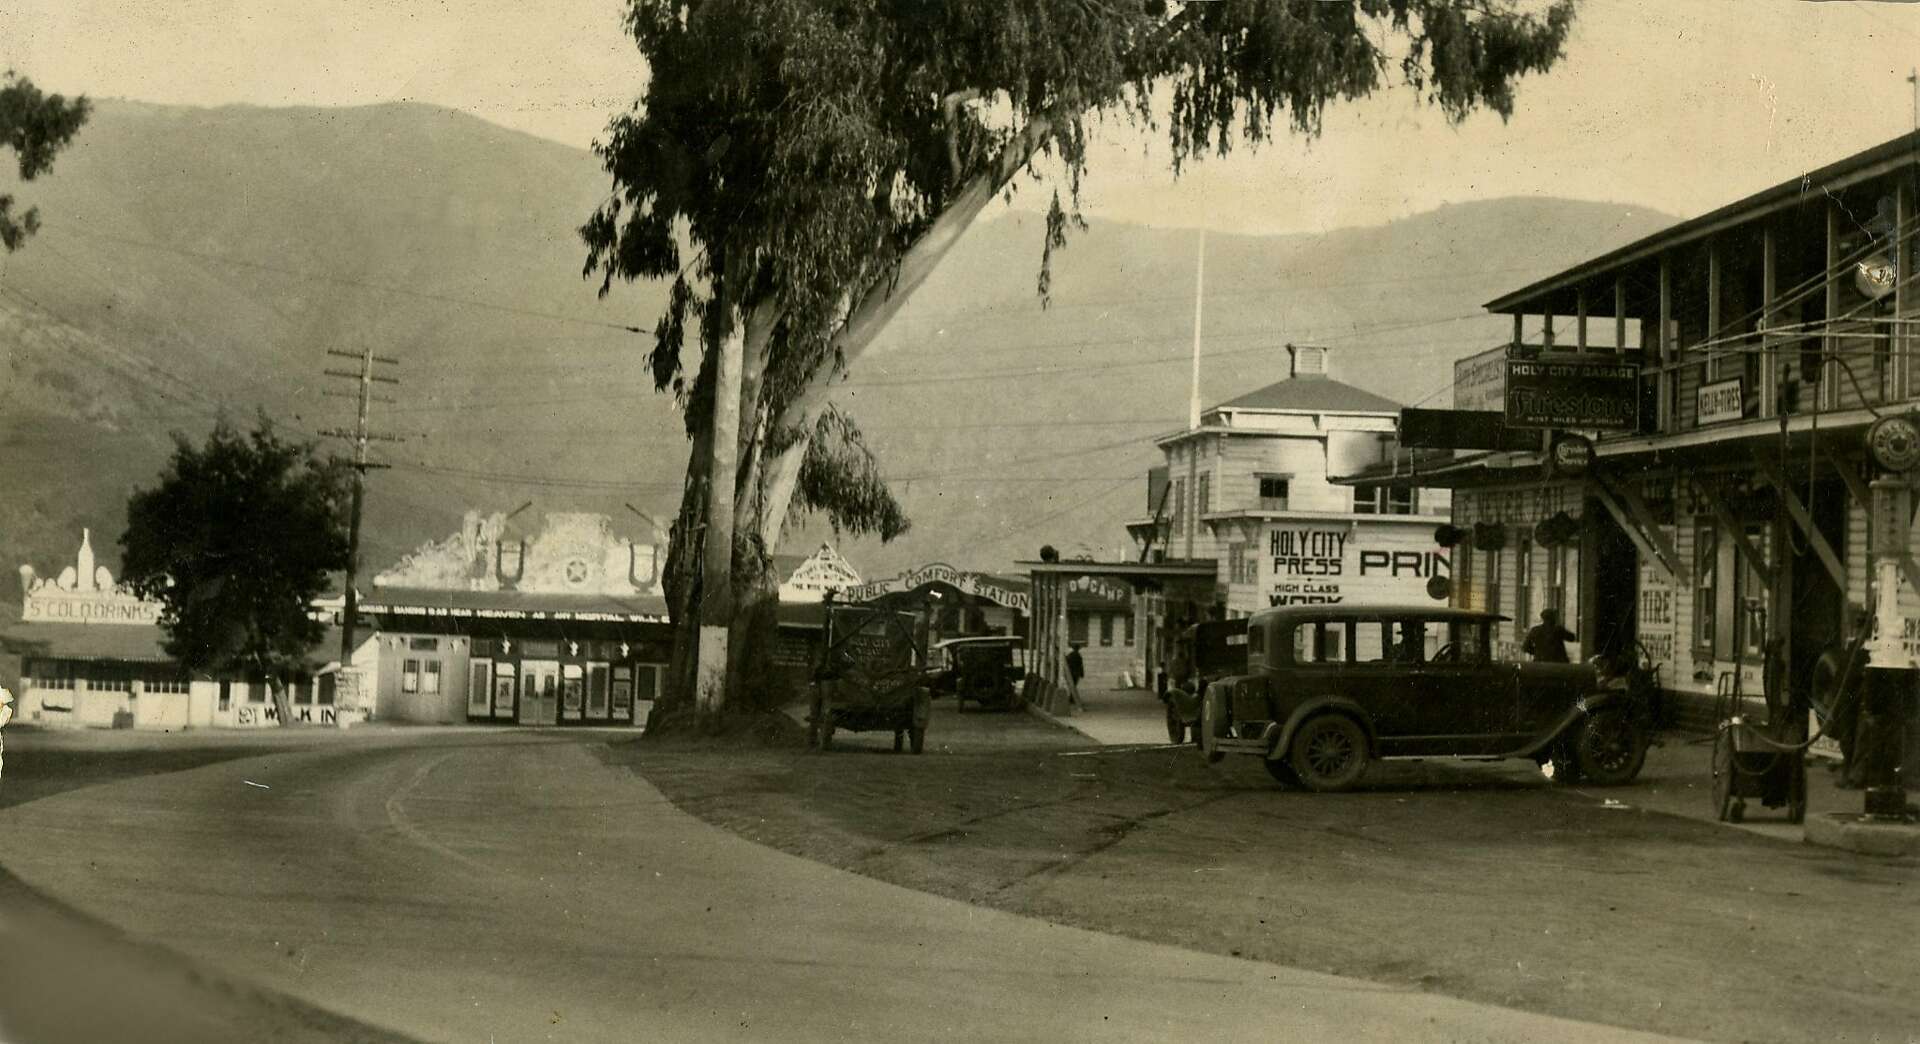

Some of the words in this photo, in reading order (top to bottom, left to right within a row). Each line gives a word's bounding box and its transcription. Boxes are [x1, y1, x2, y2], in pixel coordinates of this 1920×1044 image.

[1512, 365, 1544, 376] HOLY
[1549, 366, 1577, 377] CITY
[1582, 367, 1634, 379] GARAGE
[1510, 385, 1635, 419] Firestone
[1270, 530, 1308, 557] HOLY
[1311, 531, 1347, 558] CITY
[1274, 557, 1342, 576] PRESS
[848, 582, 890, 602] PUBLIC
[905, 567, 966, 590] COMFORT
[974, 579, 1029, 609] STATION
[1090, 579, 1125, 601] CAMP
[1274, 585, 1299, 594] HIGH
[1303, 585, 1339, 594] CLASS
[47, 601, 90, 618] COLD
[94, 602, 155, 620] DRINKS
[477, 608, 526, 619] HEAVEN
[1642, 590, 1671, 624] TIRE
[320, 708, 336, 723] IN
